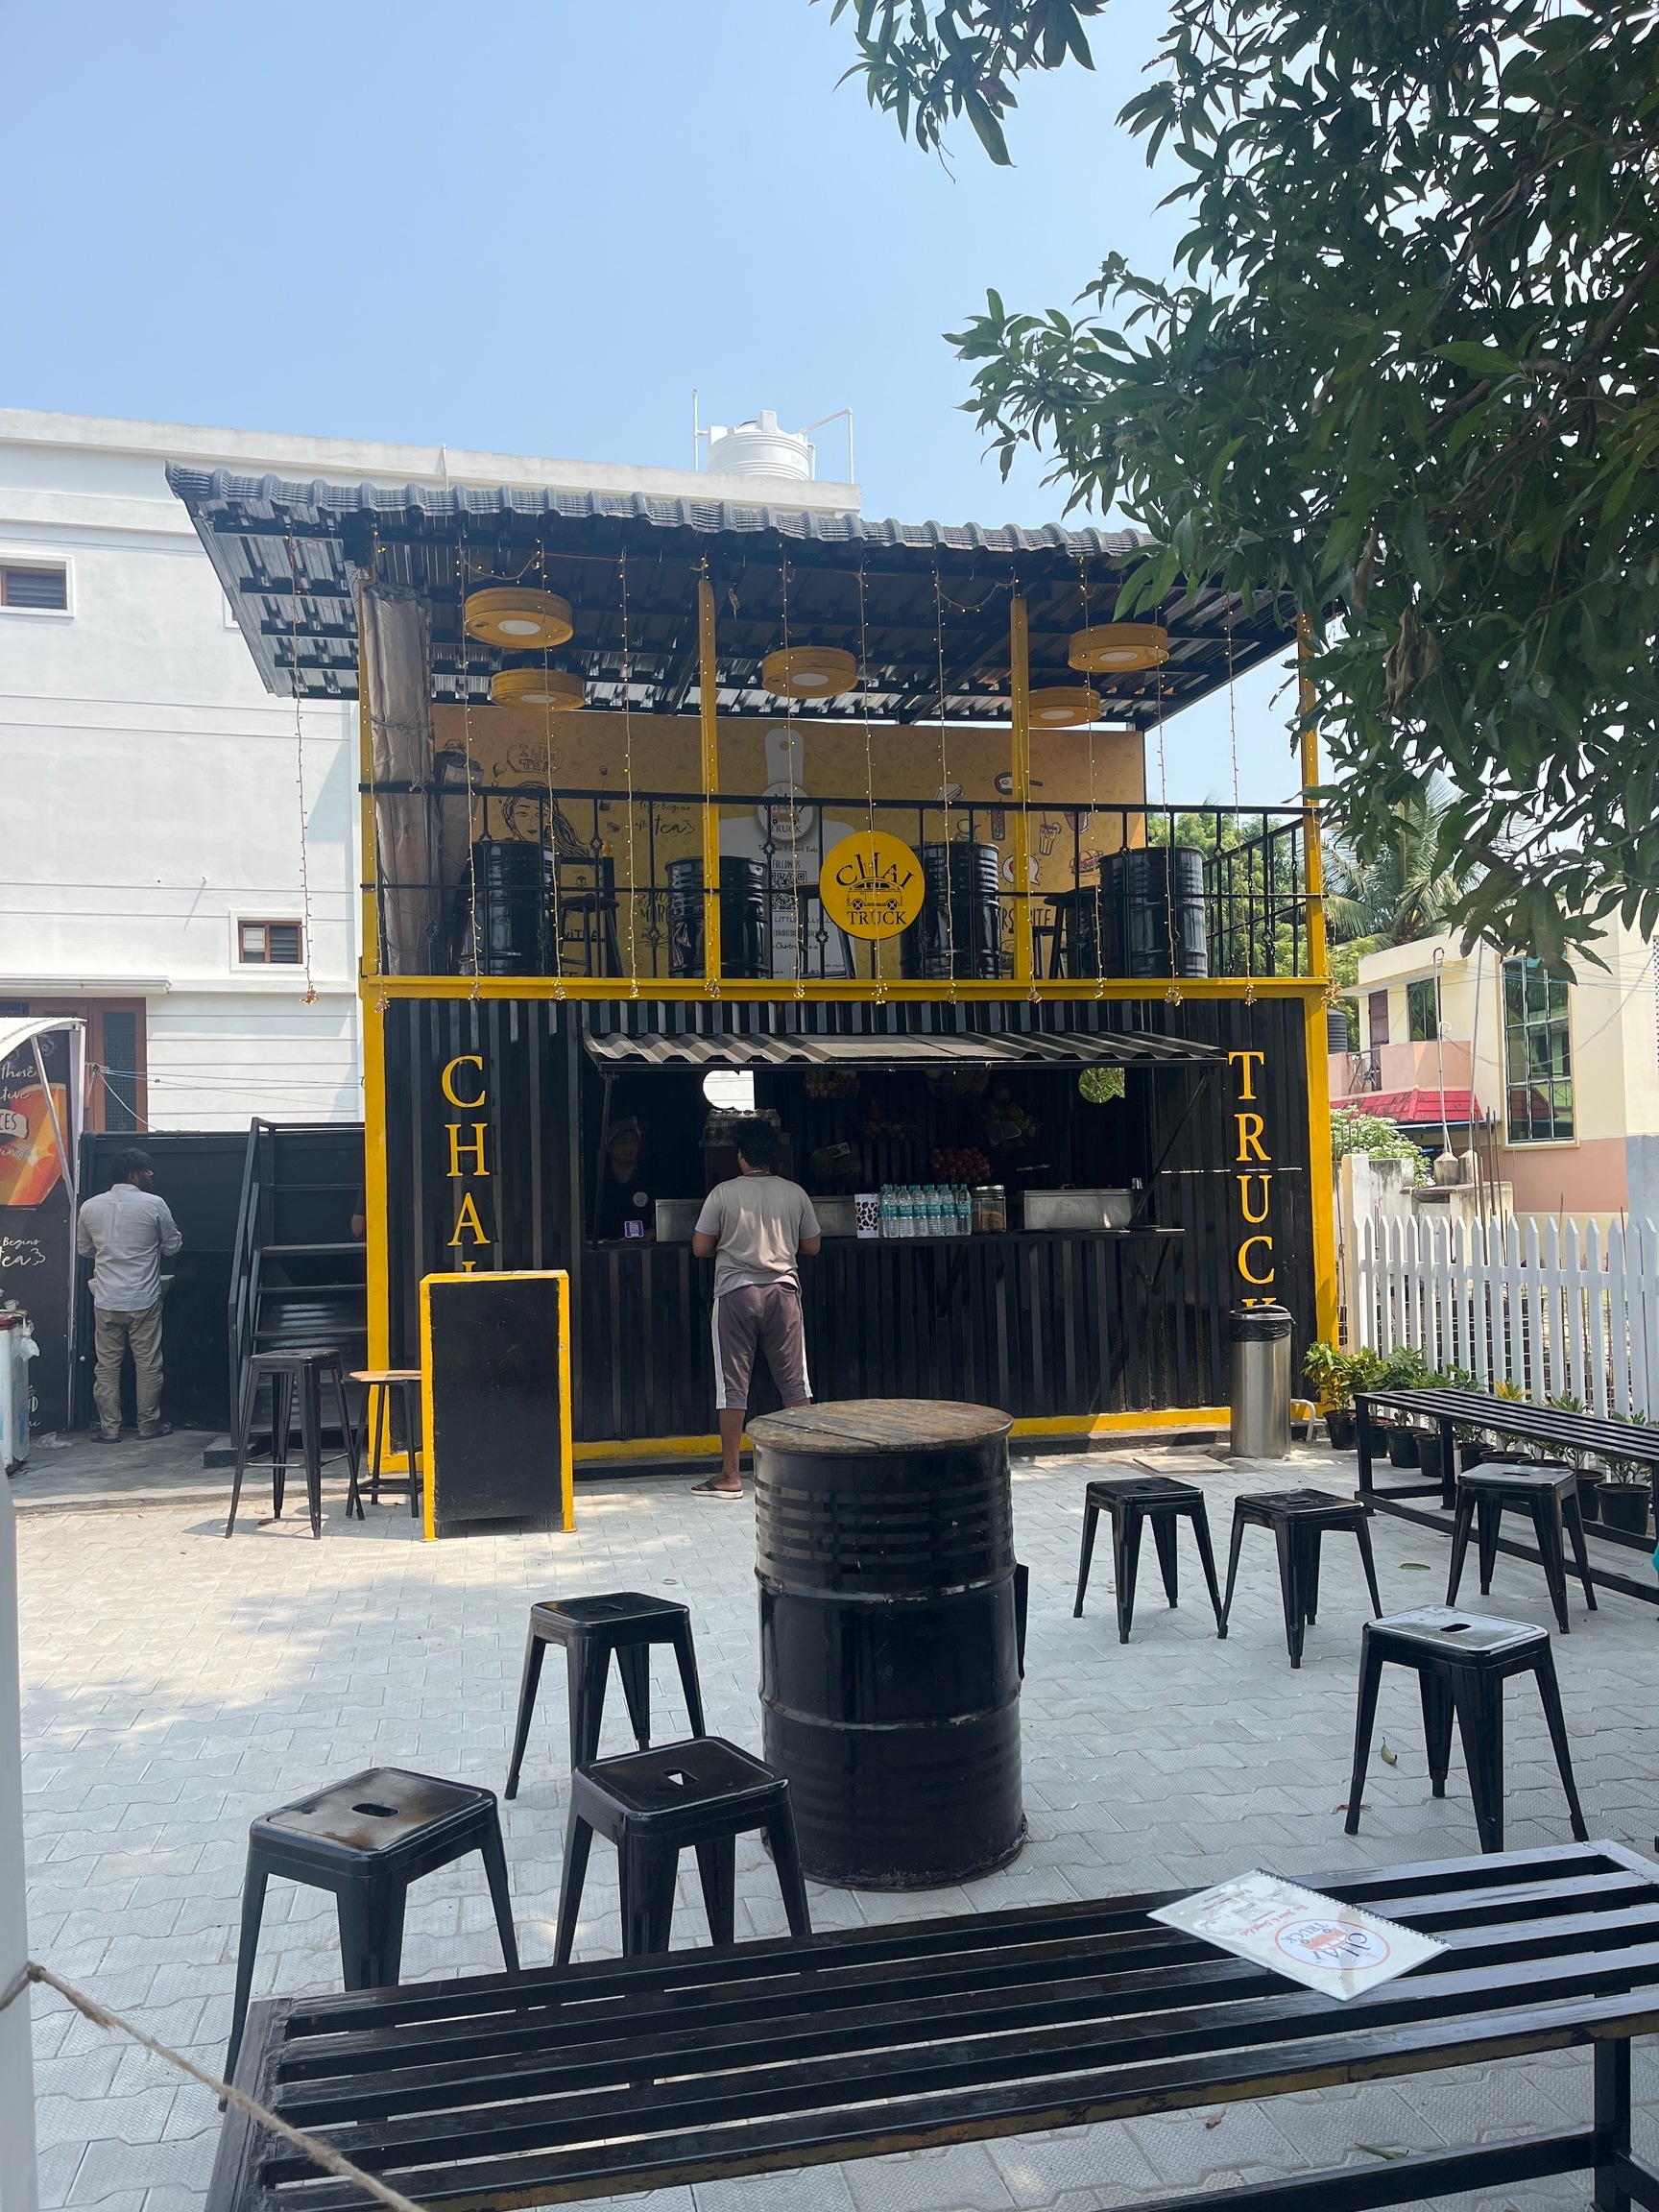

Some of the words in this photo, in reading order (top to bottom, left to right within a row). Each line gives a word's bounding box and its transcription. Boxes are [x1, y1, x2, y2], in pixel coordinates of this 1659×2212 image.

[835, 851, 916, 889] CHAI
[846, 910, 907, 926] TRUCK
[1228, 1049, 1277, 1309] TRUC
[2, 1236, 41, 1250] Begins
[1280, 1921, 1329, 1945] TRUCK
[1311, 1932, 1372, 1960] CHAI
